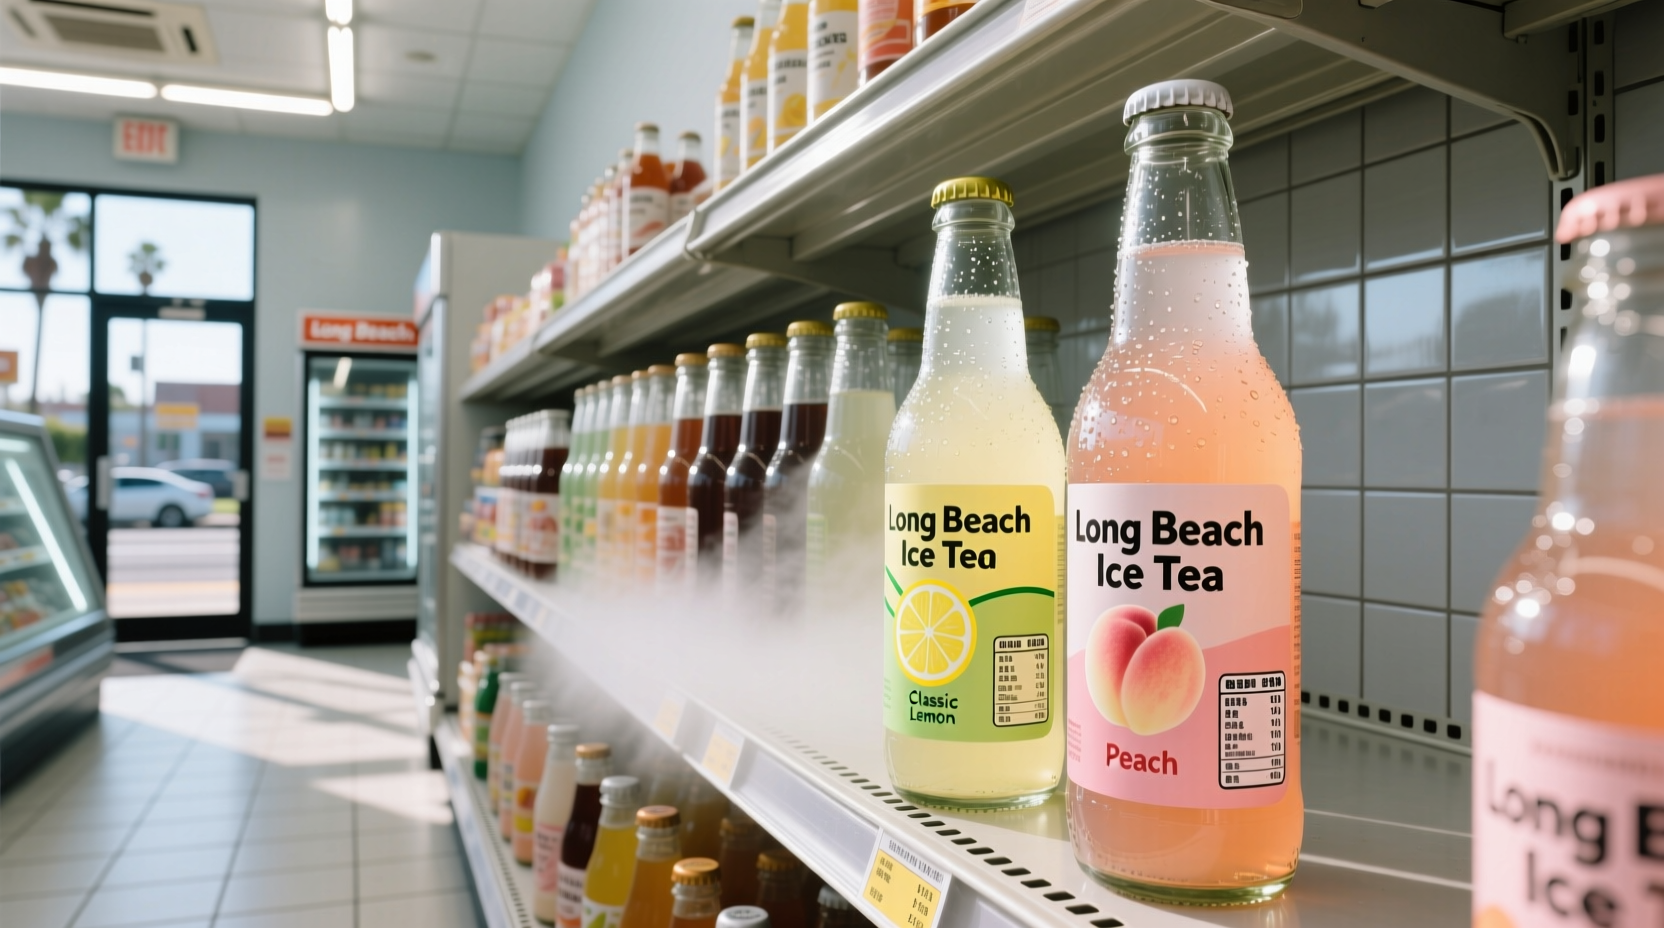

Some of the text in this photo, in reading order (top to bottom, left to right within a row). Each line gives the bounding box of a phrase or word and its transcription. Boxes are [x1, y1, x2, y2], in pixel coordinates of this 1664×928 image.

[889, 504, 1031, 543] Long Beach
[1076, 509, 1264, 556] Long Beach
[902, 540, 997, 570] Ice Tea
[1097, 552, 1224, 593] Ice Tea
[909, 690, 959, 710] Classic
[909, 706, 956, 725] Lemon
[1106, 742, 1178, 776] Peach
[1486, 759, 1608, 867] Long
